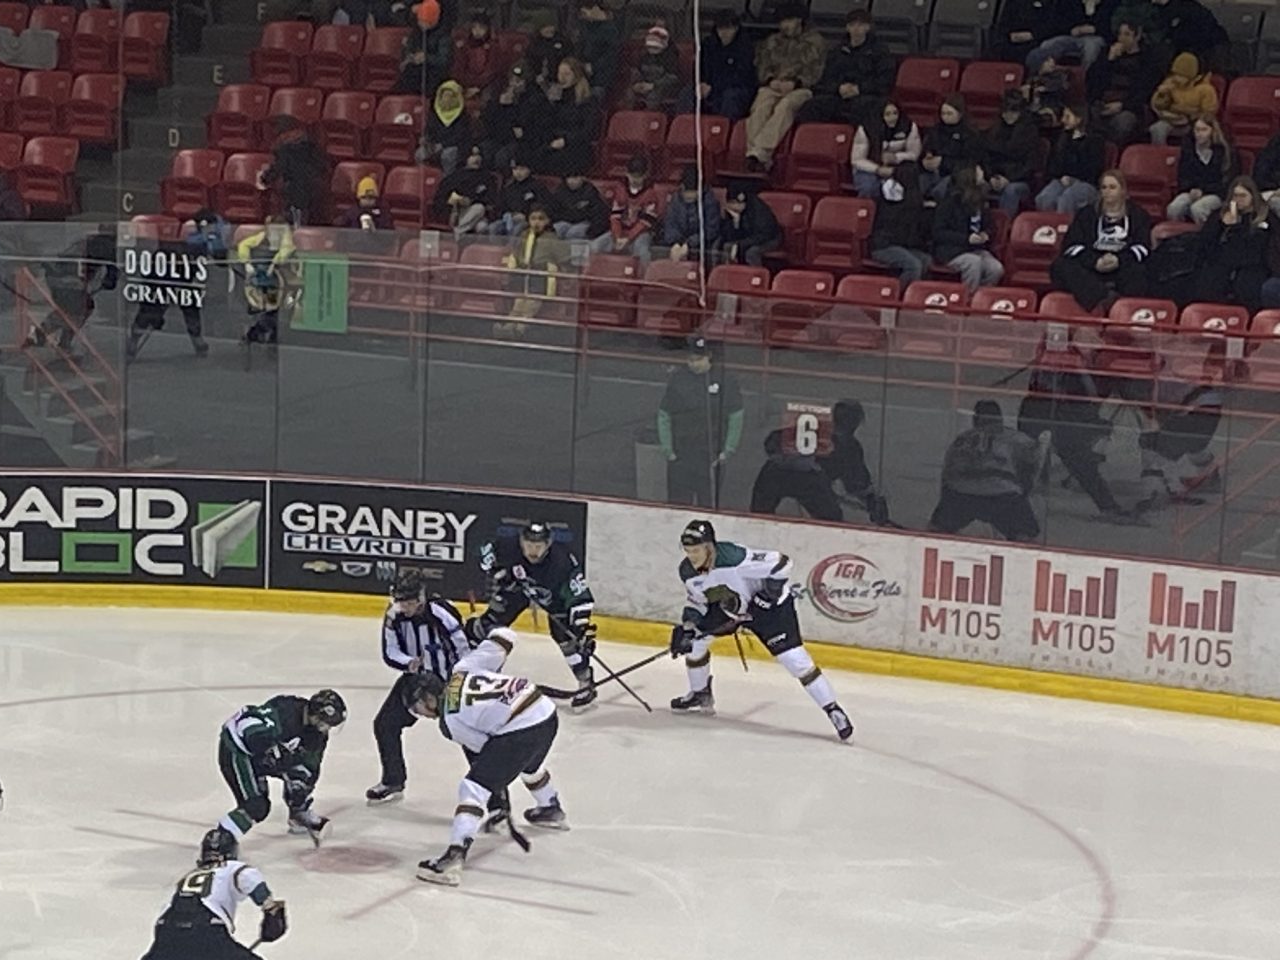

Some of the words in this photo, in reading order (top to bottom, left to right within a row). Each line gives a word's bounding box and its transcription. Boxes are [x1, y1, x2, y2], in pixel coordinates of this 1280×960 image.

[213, 65, 223, 84] E
[169, 128, 180, 147] D
[122, 193, 133, 212] C
[122, 284, 207, 308] GRANBY
[796, 414, 819, 455] 6
[281, 502, 478, 545] GRANBY
[285, 533, 463, 561] CHEVROLET
[834, 563, 866, 580] IGA
[920, 605, 1002, 641] M105
[1031, 617, 1116, 654] M105
[1146, 631, 1234, 668] M105
